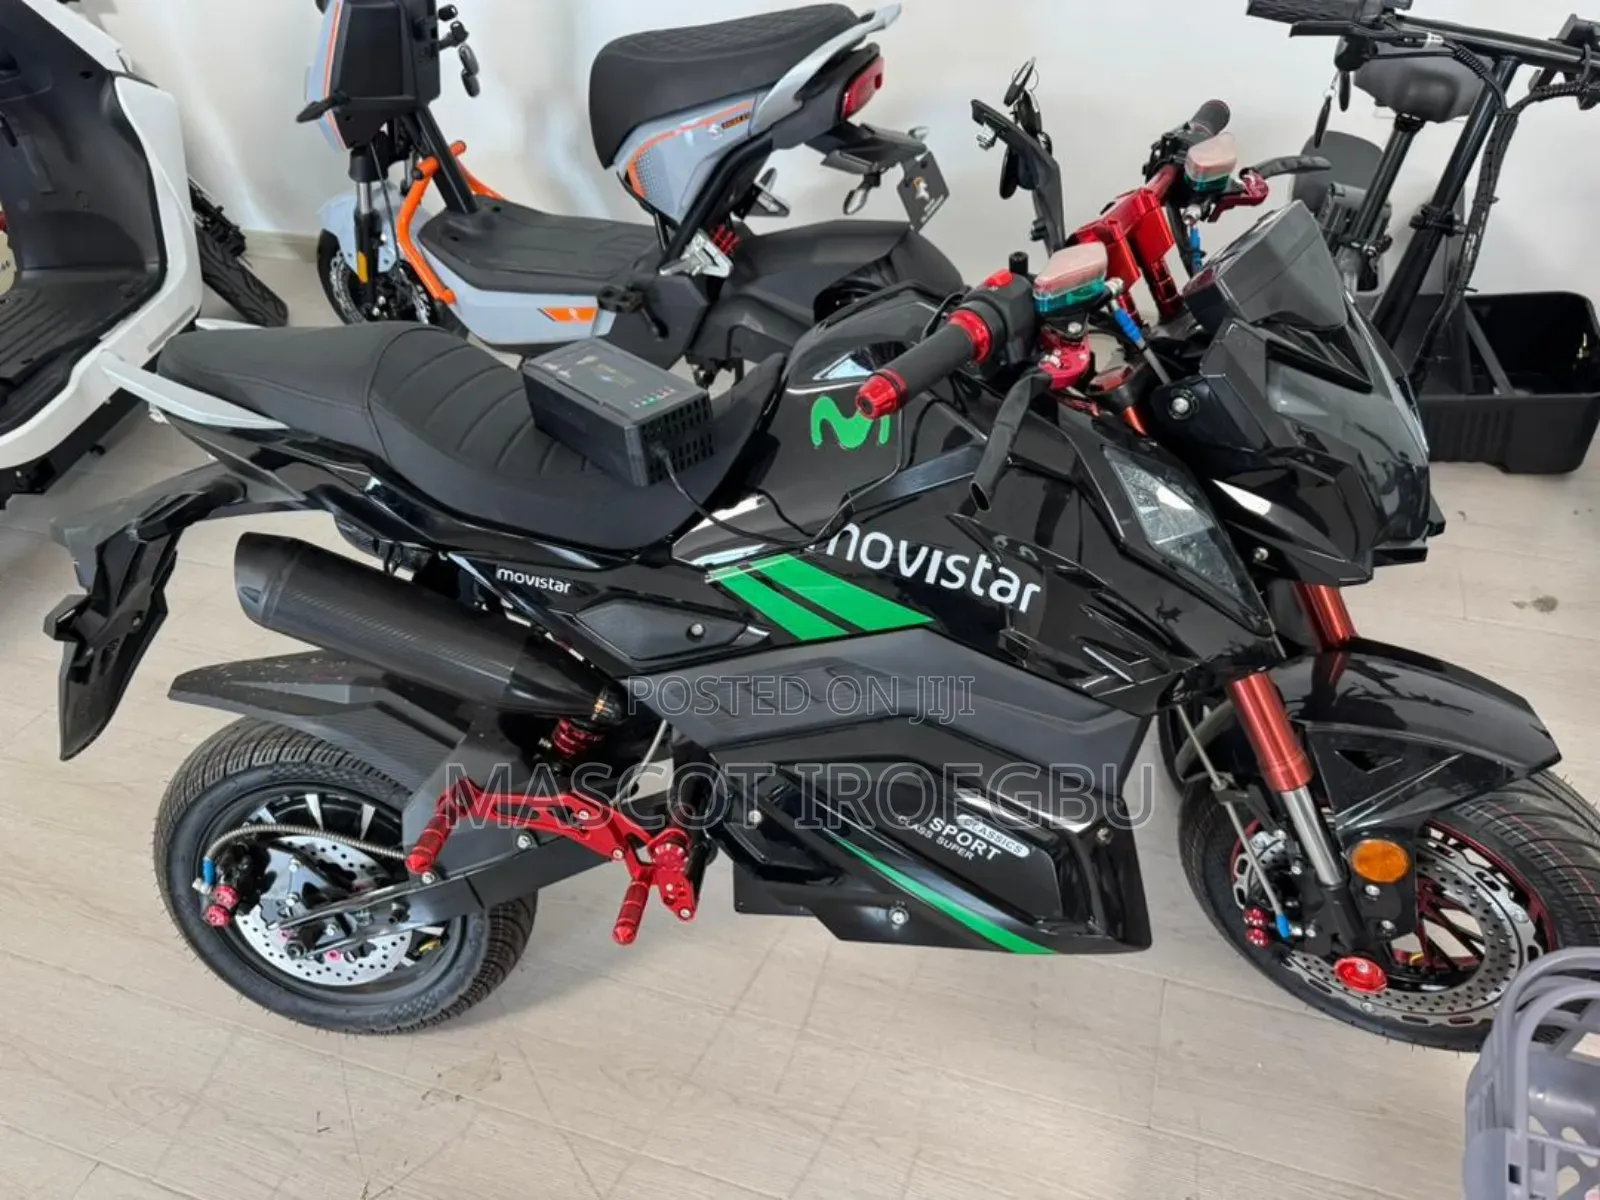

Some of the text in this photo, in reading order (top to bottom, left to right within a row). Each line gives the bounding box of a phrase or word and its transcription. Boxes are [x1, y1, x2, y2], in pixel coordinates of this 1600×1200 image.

[496, 568, 571, 594] movistar
[898, 815, 975, 861] CLASS SUPER
[929, 817, 1002, 860] SPORT
[963, 817, 1024, 854] CLASSICS
